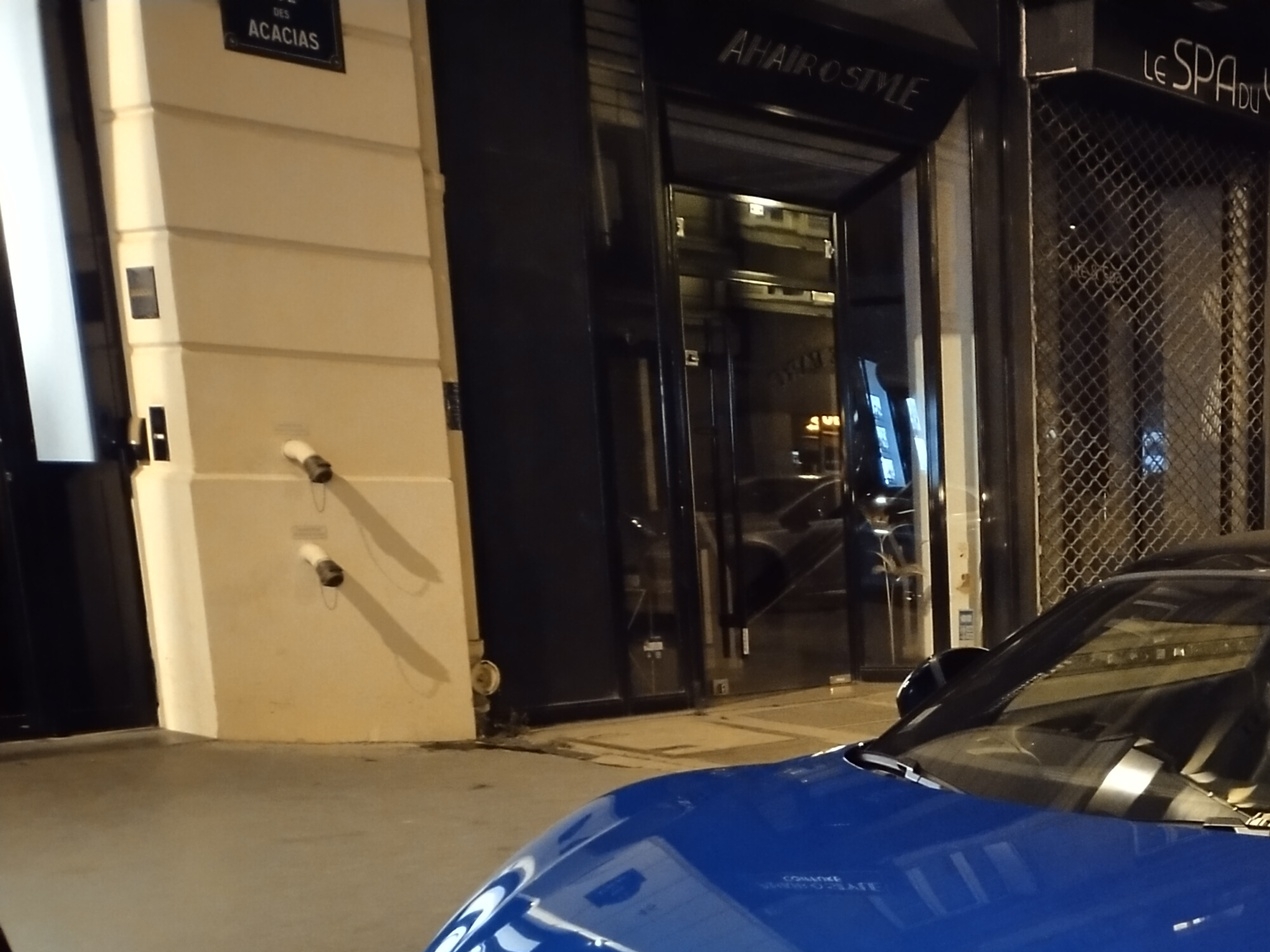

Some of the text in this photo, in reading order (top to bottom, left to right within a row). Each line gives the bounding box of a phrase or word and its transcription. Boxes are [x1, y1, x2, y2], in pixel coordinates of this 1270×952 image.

[273, 7, 290, 19] DES
[248, 18, 320, 50] ACACIAS
[1143, 49, 1167, 85] LE
[1172, 38, 1237, 107] SPA
[1238, 81, 1261, 114] DU
